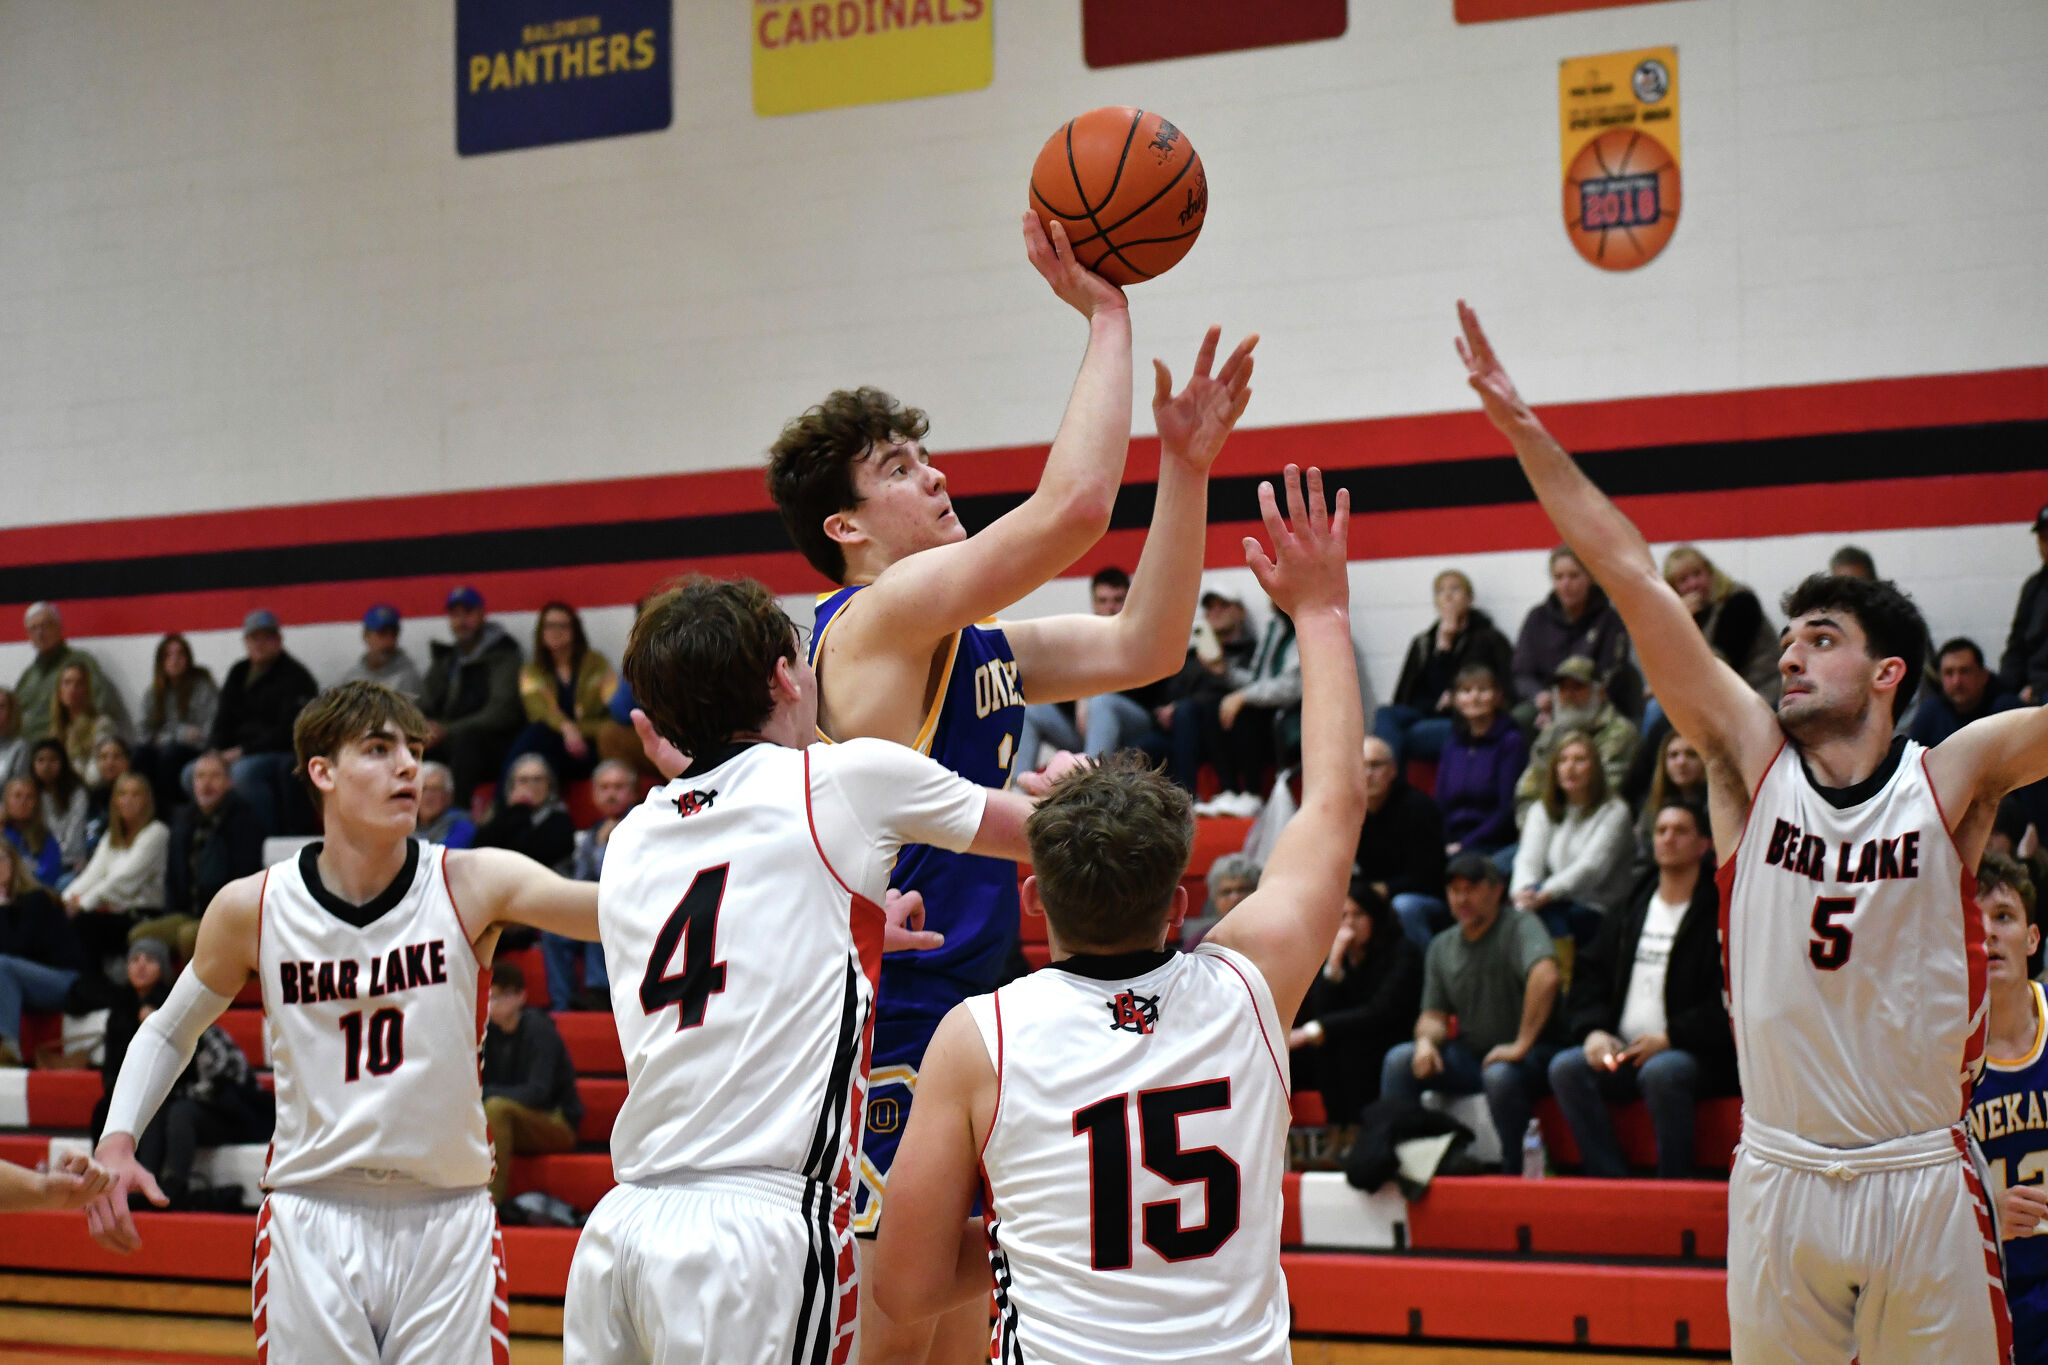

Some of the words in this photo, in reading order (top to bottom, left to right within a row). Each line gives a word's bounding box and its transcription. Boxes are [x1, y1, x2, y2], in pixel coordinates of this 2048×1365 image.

[758, 0, 984, 49] CARDINALS
[469, 29, 656, 95] PANTHERS
[975, 658, 1026, 719] ONE
[1765, 817, 1826, 882] BEAR
[1836, 830, 1920, 883] LAKE
[638, 861, 730, 1033] 4
[1808, 895, 1857, 971] 5
[280, 958, 359, 1005] BEAR
[369, 939, 447, 997] LAKE
[339, 1006, 404, 1083] 10
[1968, 1090, 2048, 1143] NEKA
[1072, 1076, 1241, 1271] 15
